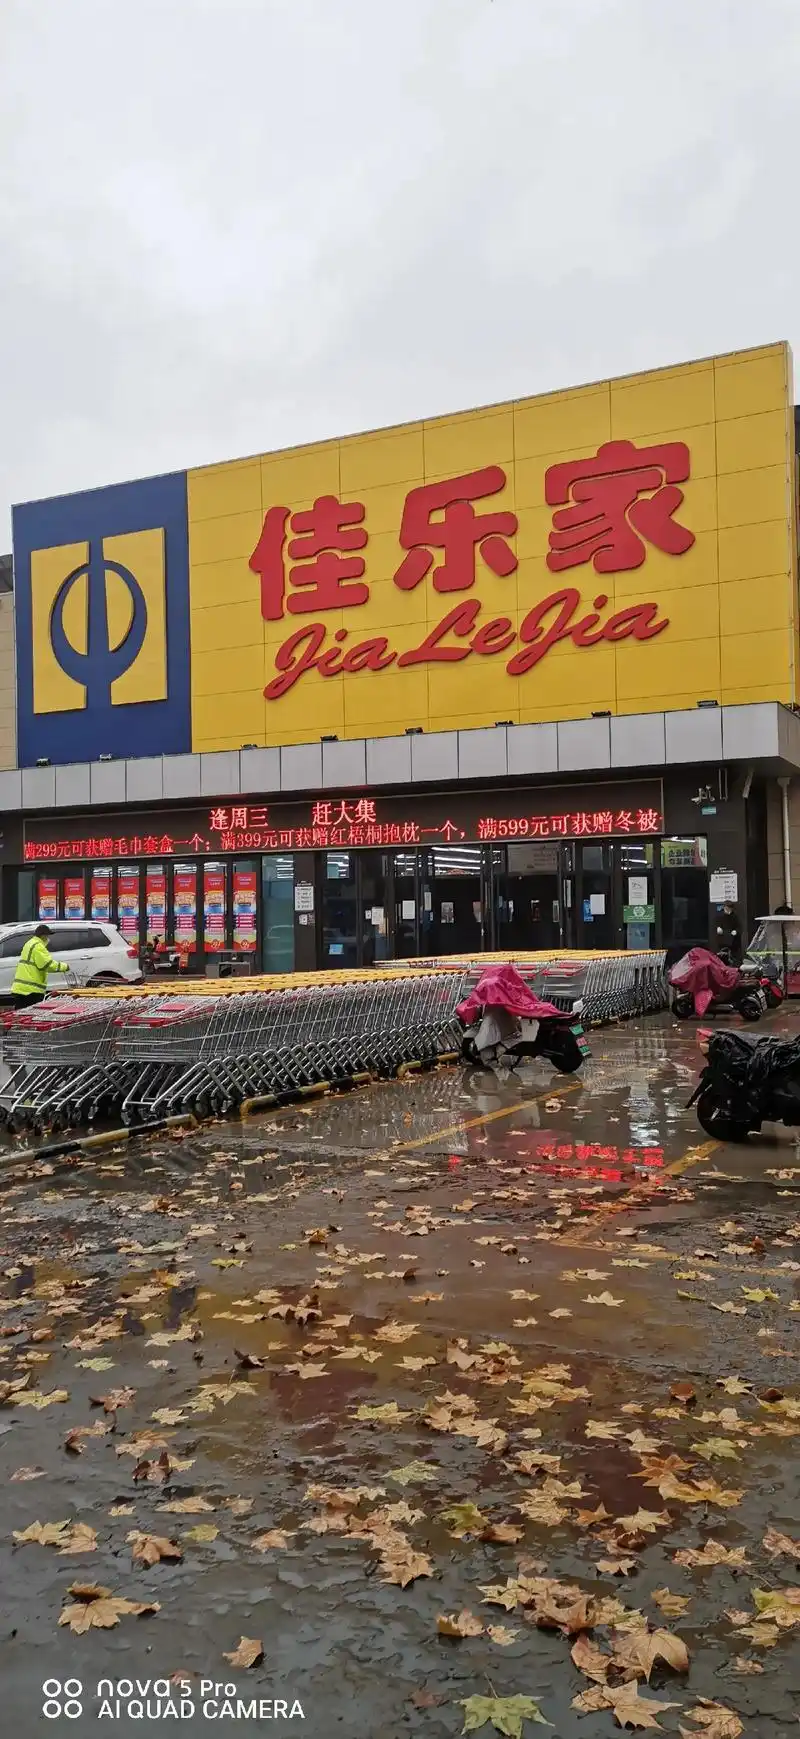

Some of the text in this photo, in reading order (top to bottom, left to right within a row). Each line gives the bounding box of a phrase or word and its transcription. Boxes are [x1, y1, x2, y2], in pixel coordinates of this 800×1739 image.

[249, 440, 696, 620] 佳乐家
[209, 799, 377, 831] 逢周三 赶大集
